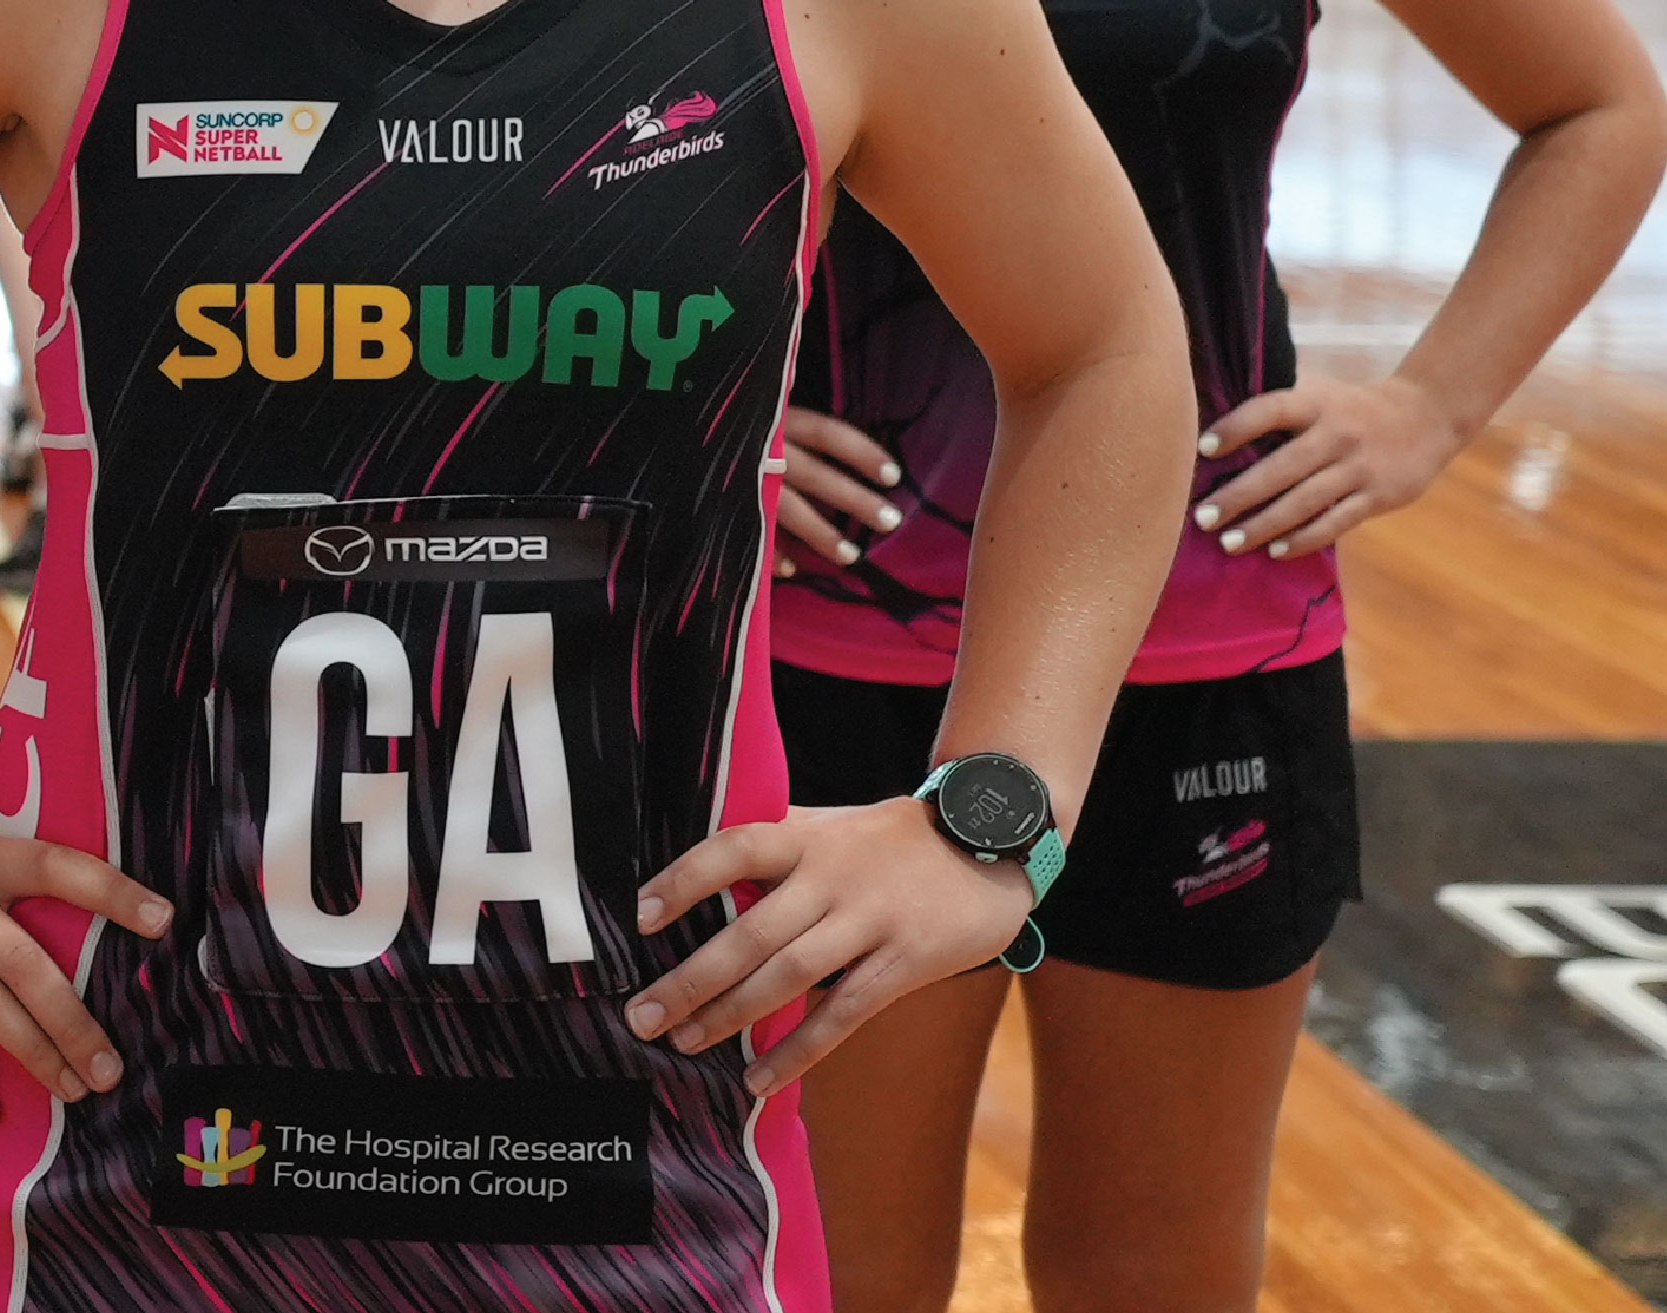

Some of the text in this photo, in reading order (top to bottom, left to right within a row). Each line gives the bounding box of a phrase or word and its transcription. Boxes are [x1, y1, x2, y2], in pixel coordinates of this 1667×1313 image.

[195, 112, 284, 129] SUNCORP
[195, 130, 259, 145] SUPER
[378, 116, 524, 164] VALOUR
[195, 145, 284, 163] NETBALL
[587, 130, 725, 191] Thunderbirds
[158, 283, 735, 390] SUBWAY
[263, 611, 595, 968] GA
[1174, 755, 1268, 803] VALOUR
[275, 1125, 633, 1165] The Hospital Research
[274, 1161, 568, 1203] Foundation Group
